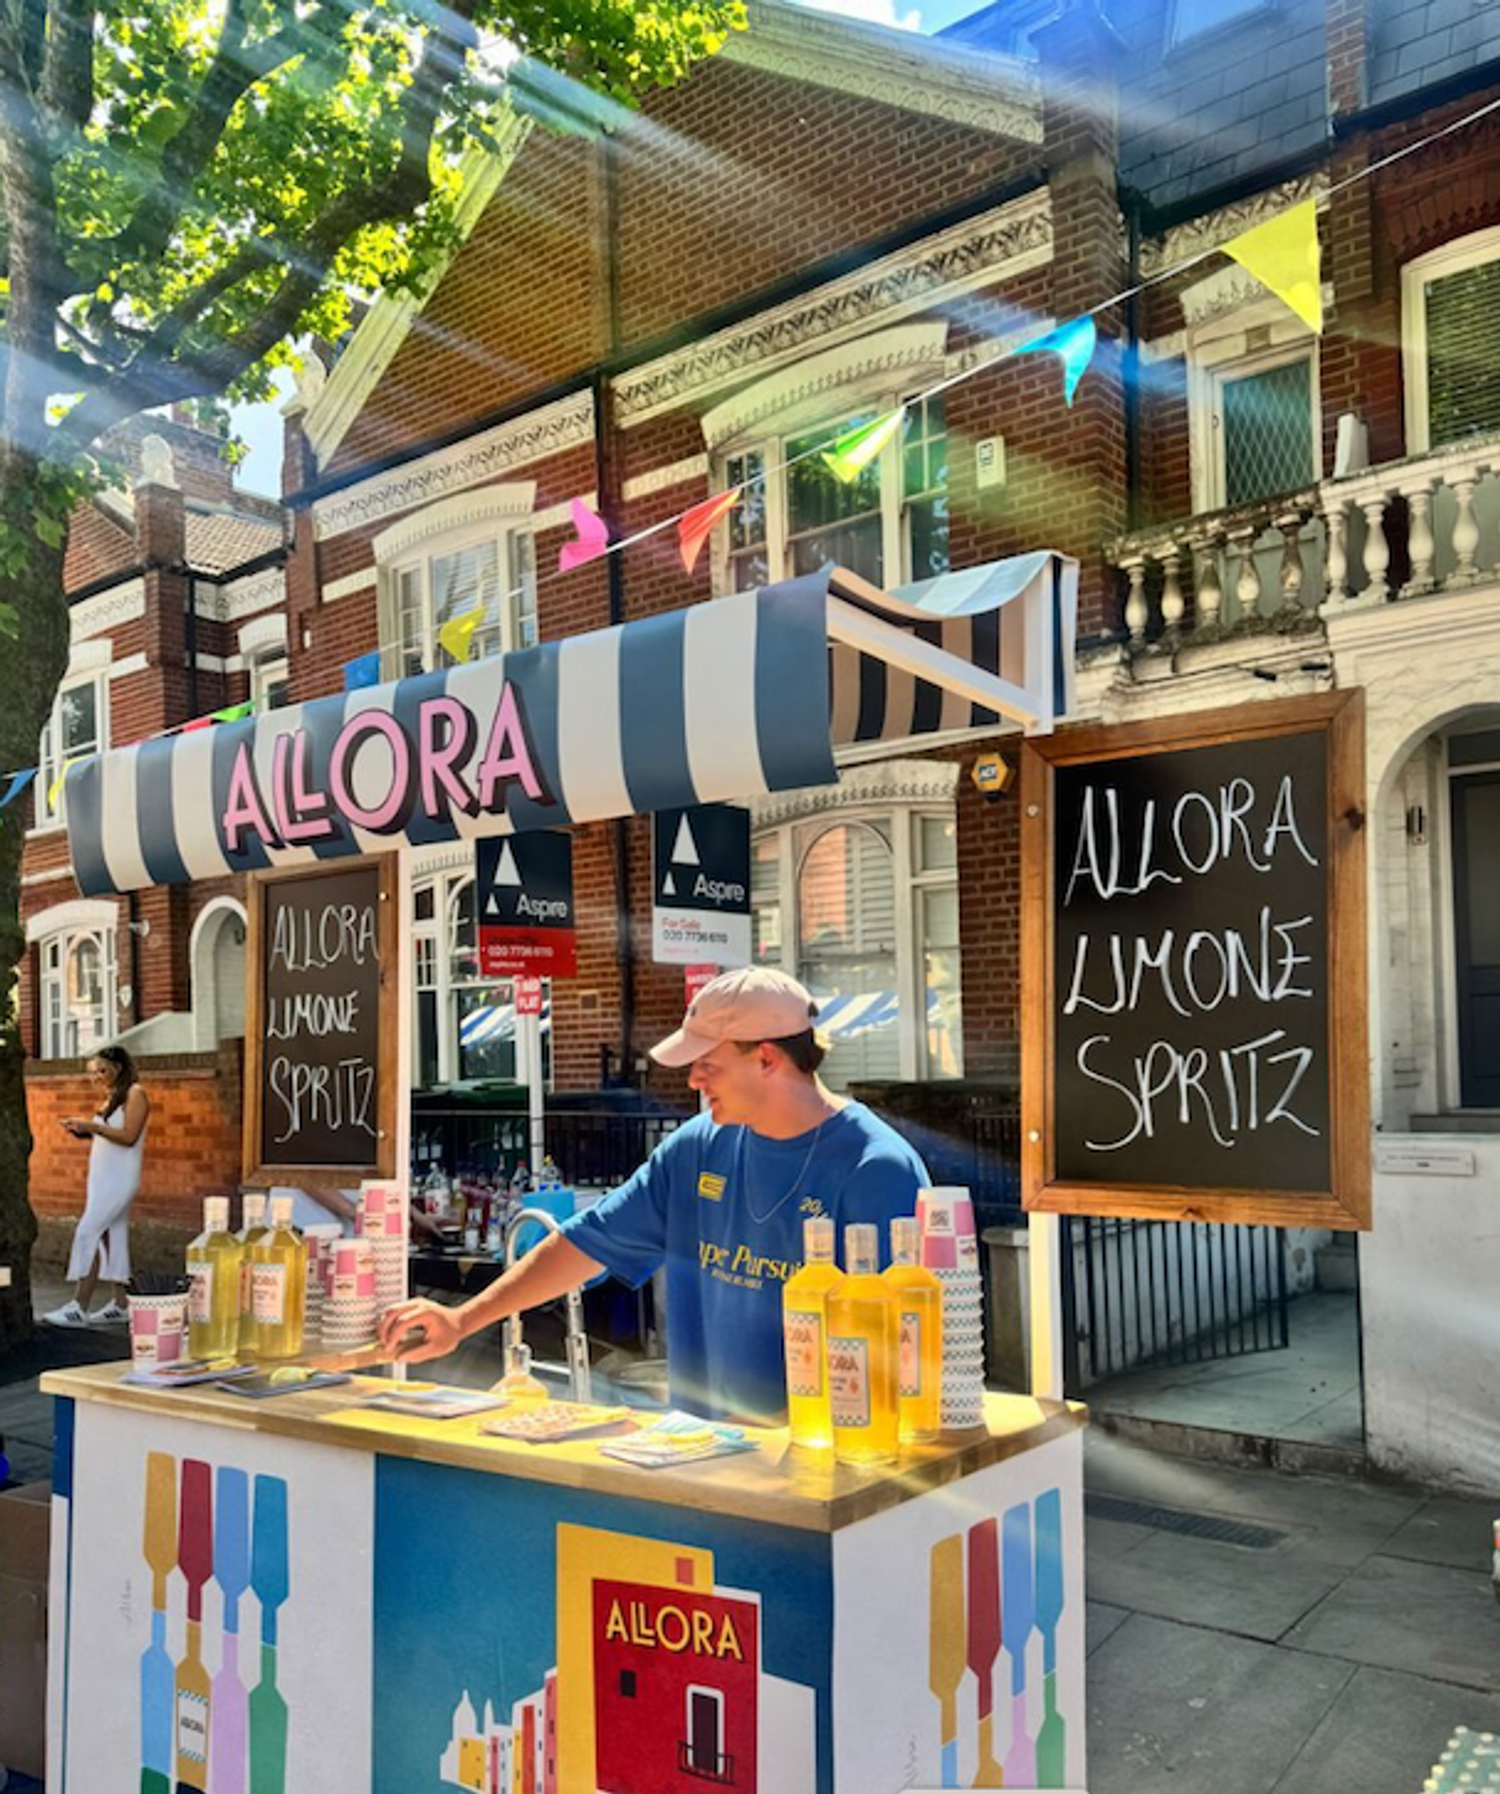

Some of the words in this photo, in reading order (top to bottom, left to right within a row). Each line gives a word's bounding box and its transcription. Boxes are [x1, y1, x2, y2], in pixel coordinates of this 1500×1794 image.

[222, 680, 554, 851] ALLORA
[1064, 775, 1319, 907] ALLORA
[516, 893, 568, 922] Aspire
[693, 872, 745, 906] Aspire
[269, 904, 380, 971] ALLORA
[1063, 906, 1314, 1017] LIMONE
[267, 990, 359, 1038] LIMONE
[269, 1056, 378, 1143] SPRITZ
[1077, 1029, 1321, 1151] SPRITZ
[605, 1599, 743, 1661] ALLORA
